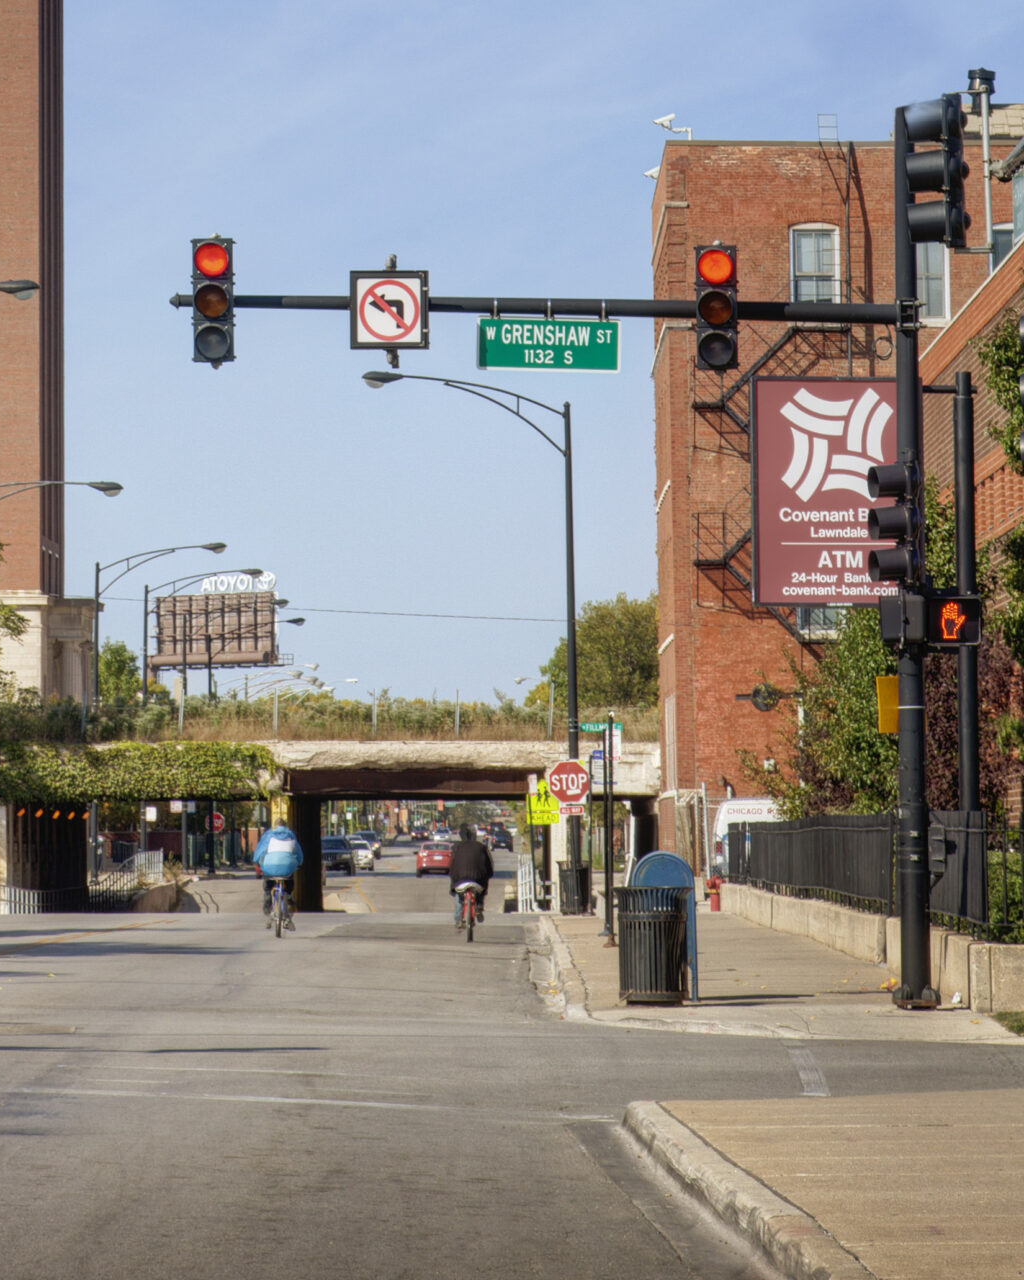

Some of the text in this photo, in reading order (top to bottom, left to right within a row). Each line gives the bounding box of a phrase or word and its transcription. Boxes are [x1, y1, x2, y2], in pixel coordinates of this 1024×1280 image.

[485, 324, 613, 347] W GRENSHAW ST
[524, 349, 573, 365] 1132 S
[779, 507, 855, 522] Covenant
[810, 526, 868, 538] Lawndale
[818, 550, 863, 568] ATM
[791, 573, 890, 585] 24-Hour Bank
[782, 585, 899, 596] covenant-bank.com
[551, 773, 587, 791] STOP
